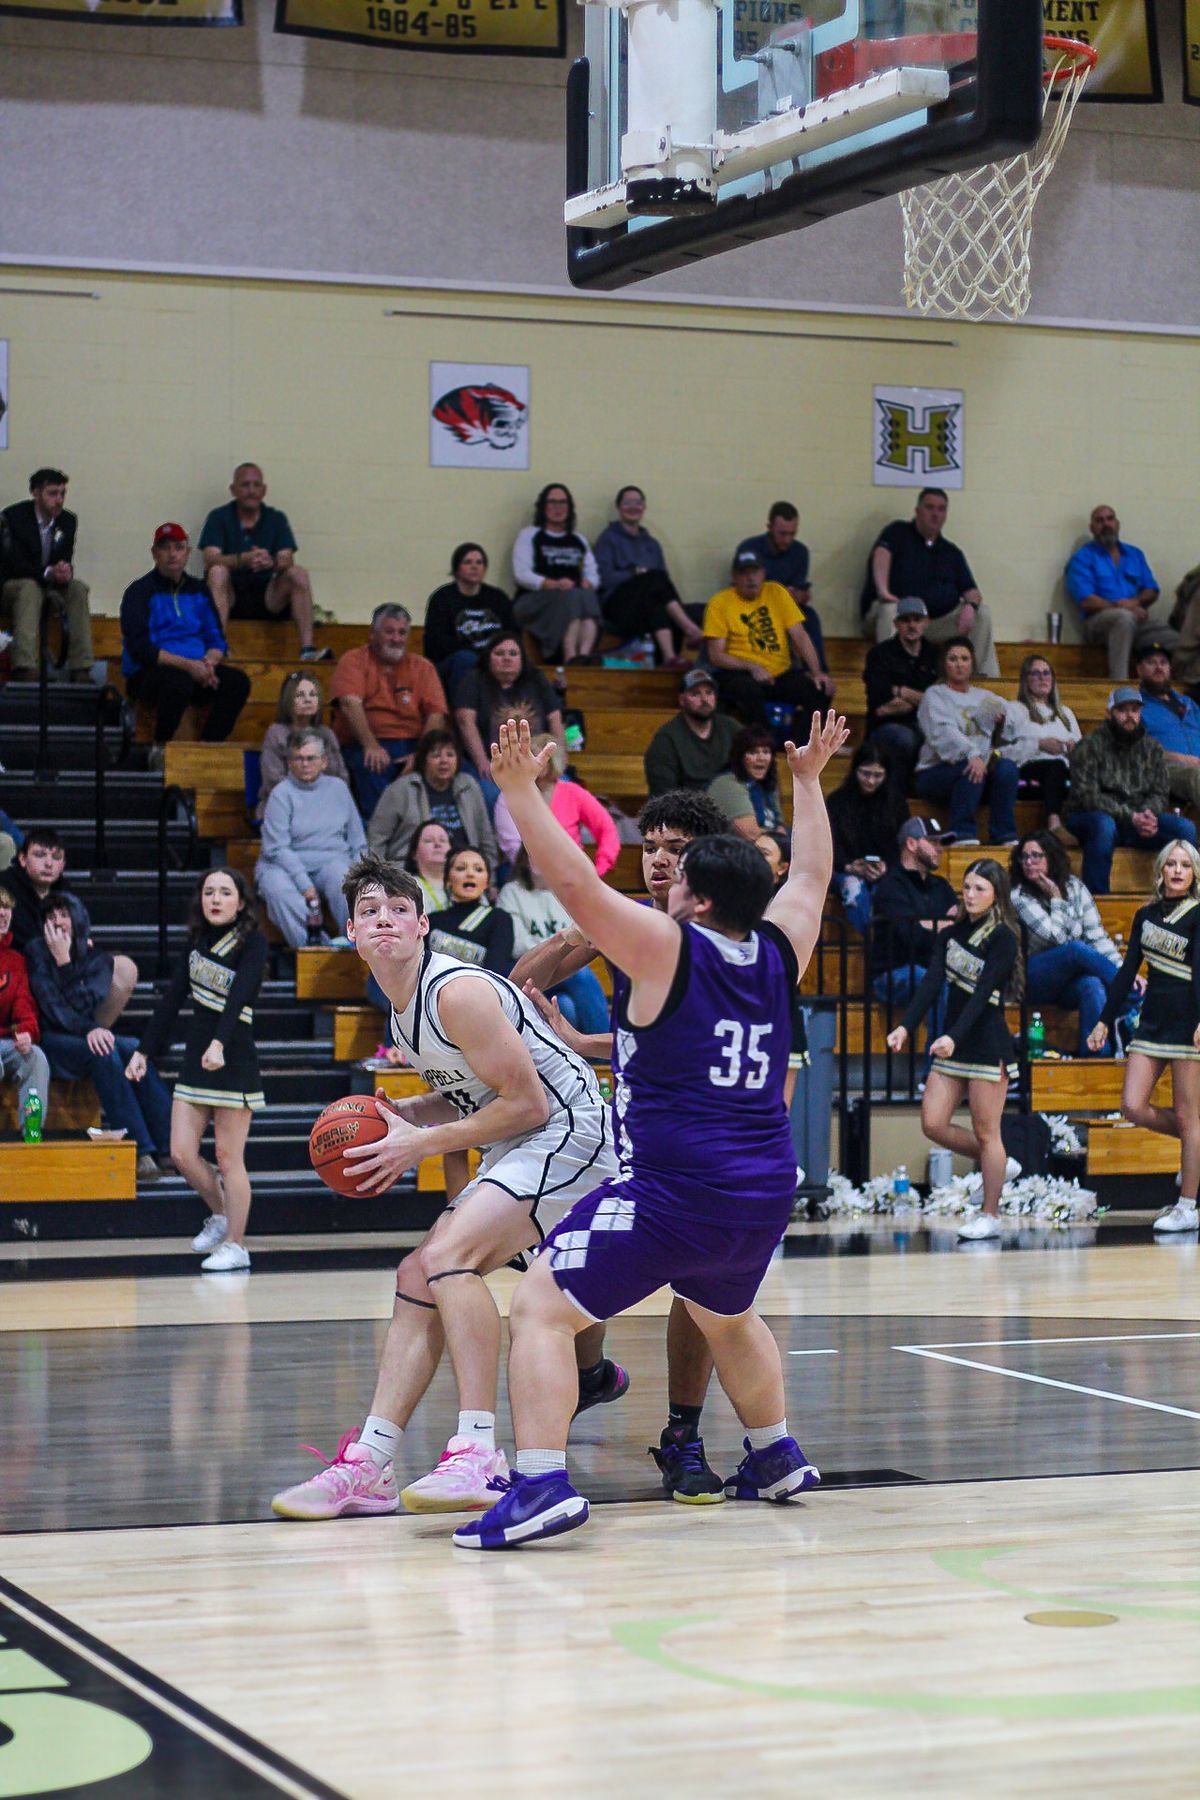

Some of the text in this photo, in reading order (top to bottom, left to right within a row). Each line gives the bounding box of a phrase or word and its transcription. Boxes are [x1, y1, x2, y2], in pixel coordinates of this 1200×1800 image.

[366, 6, 476, 38] 1984-85
[757, 605, 780, 653] PRIDE
[708, 1018, 773, 1089] 35
